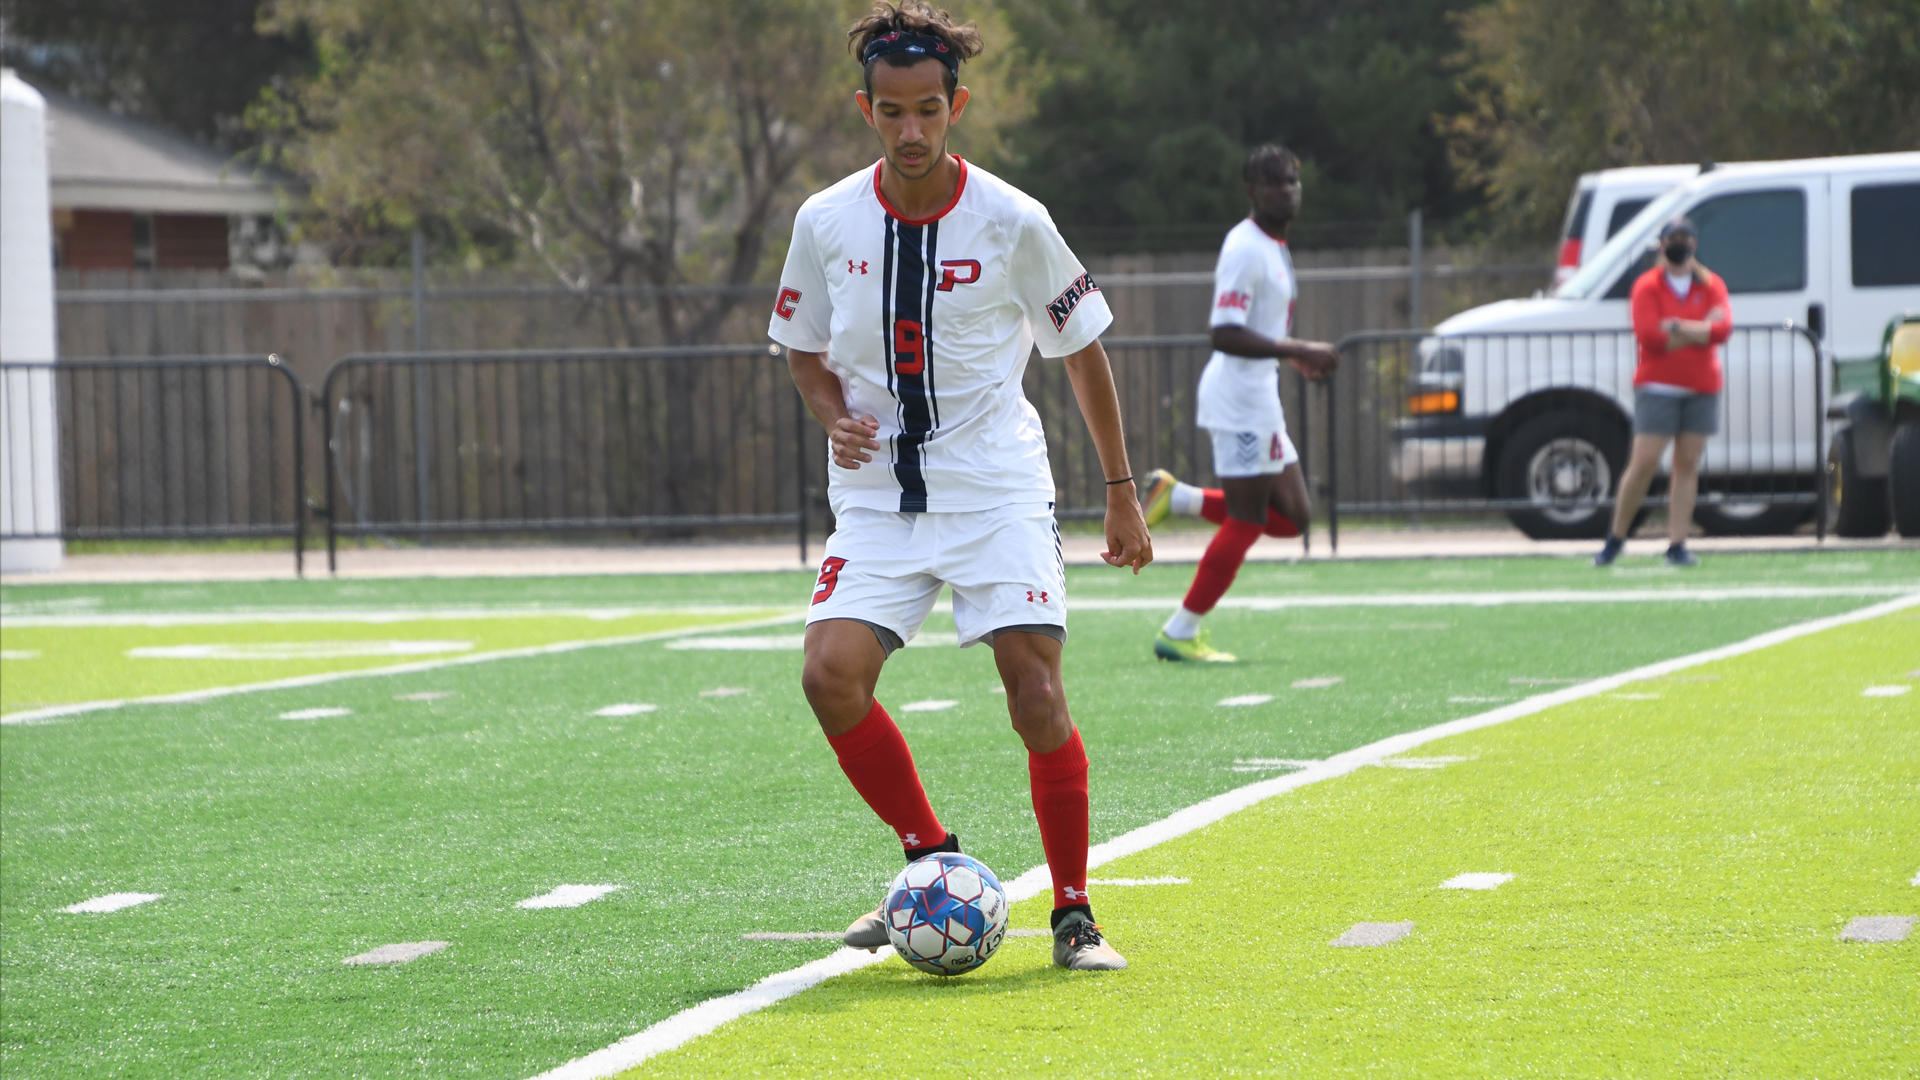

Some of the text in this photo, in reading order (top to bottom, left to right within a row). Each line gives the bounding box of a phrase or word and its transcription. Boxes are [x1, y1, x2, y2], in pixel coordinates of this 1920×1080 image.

[936, 259, 981, 292] P
[1047, 272, 1099, 328] NAIA
[894, 319, 924, 375] 9
[811, 556, 850, 606] 9
